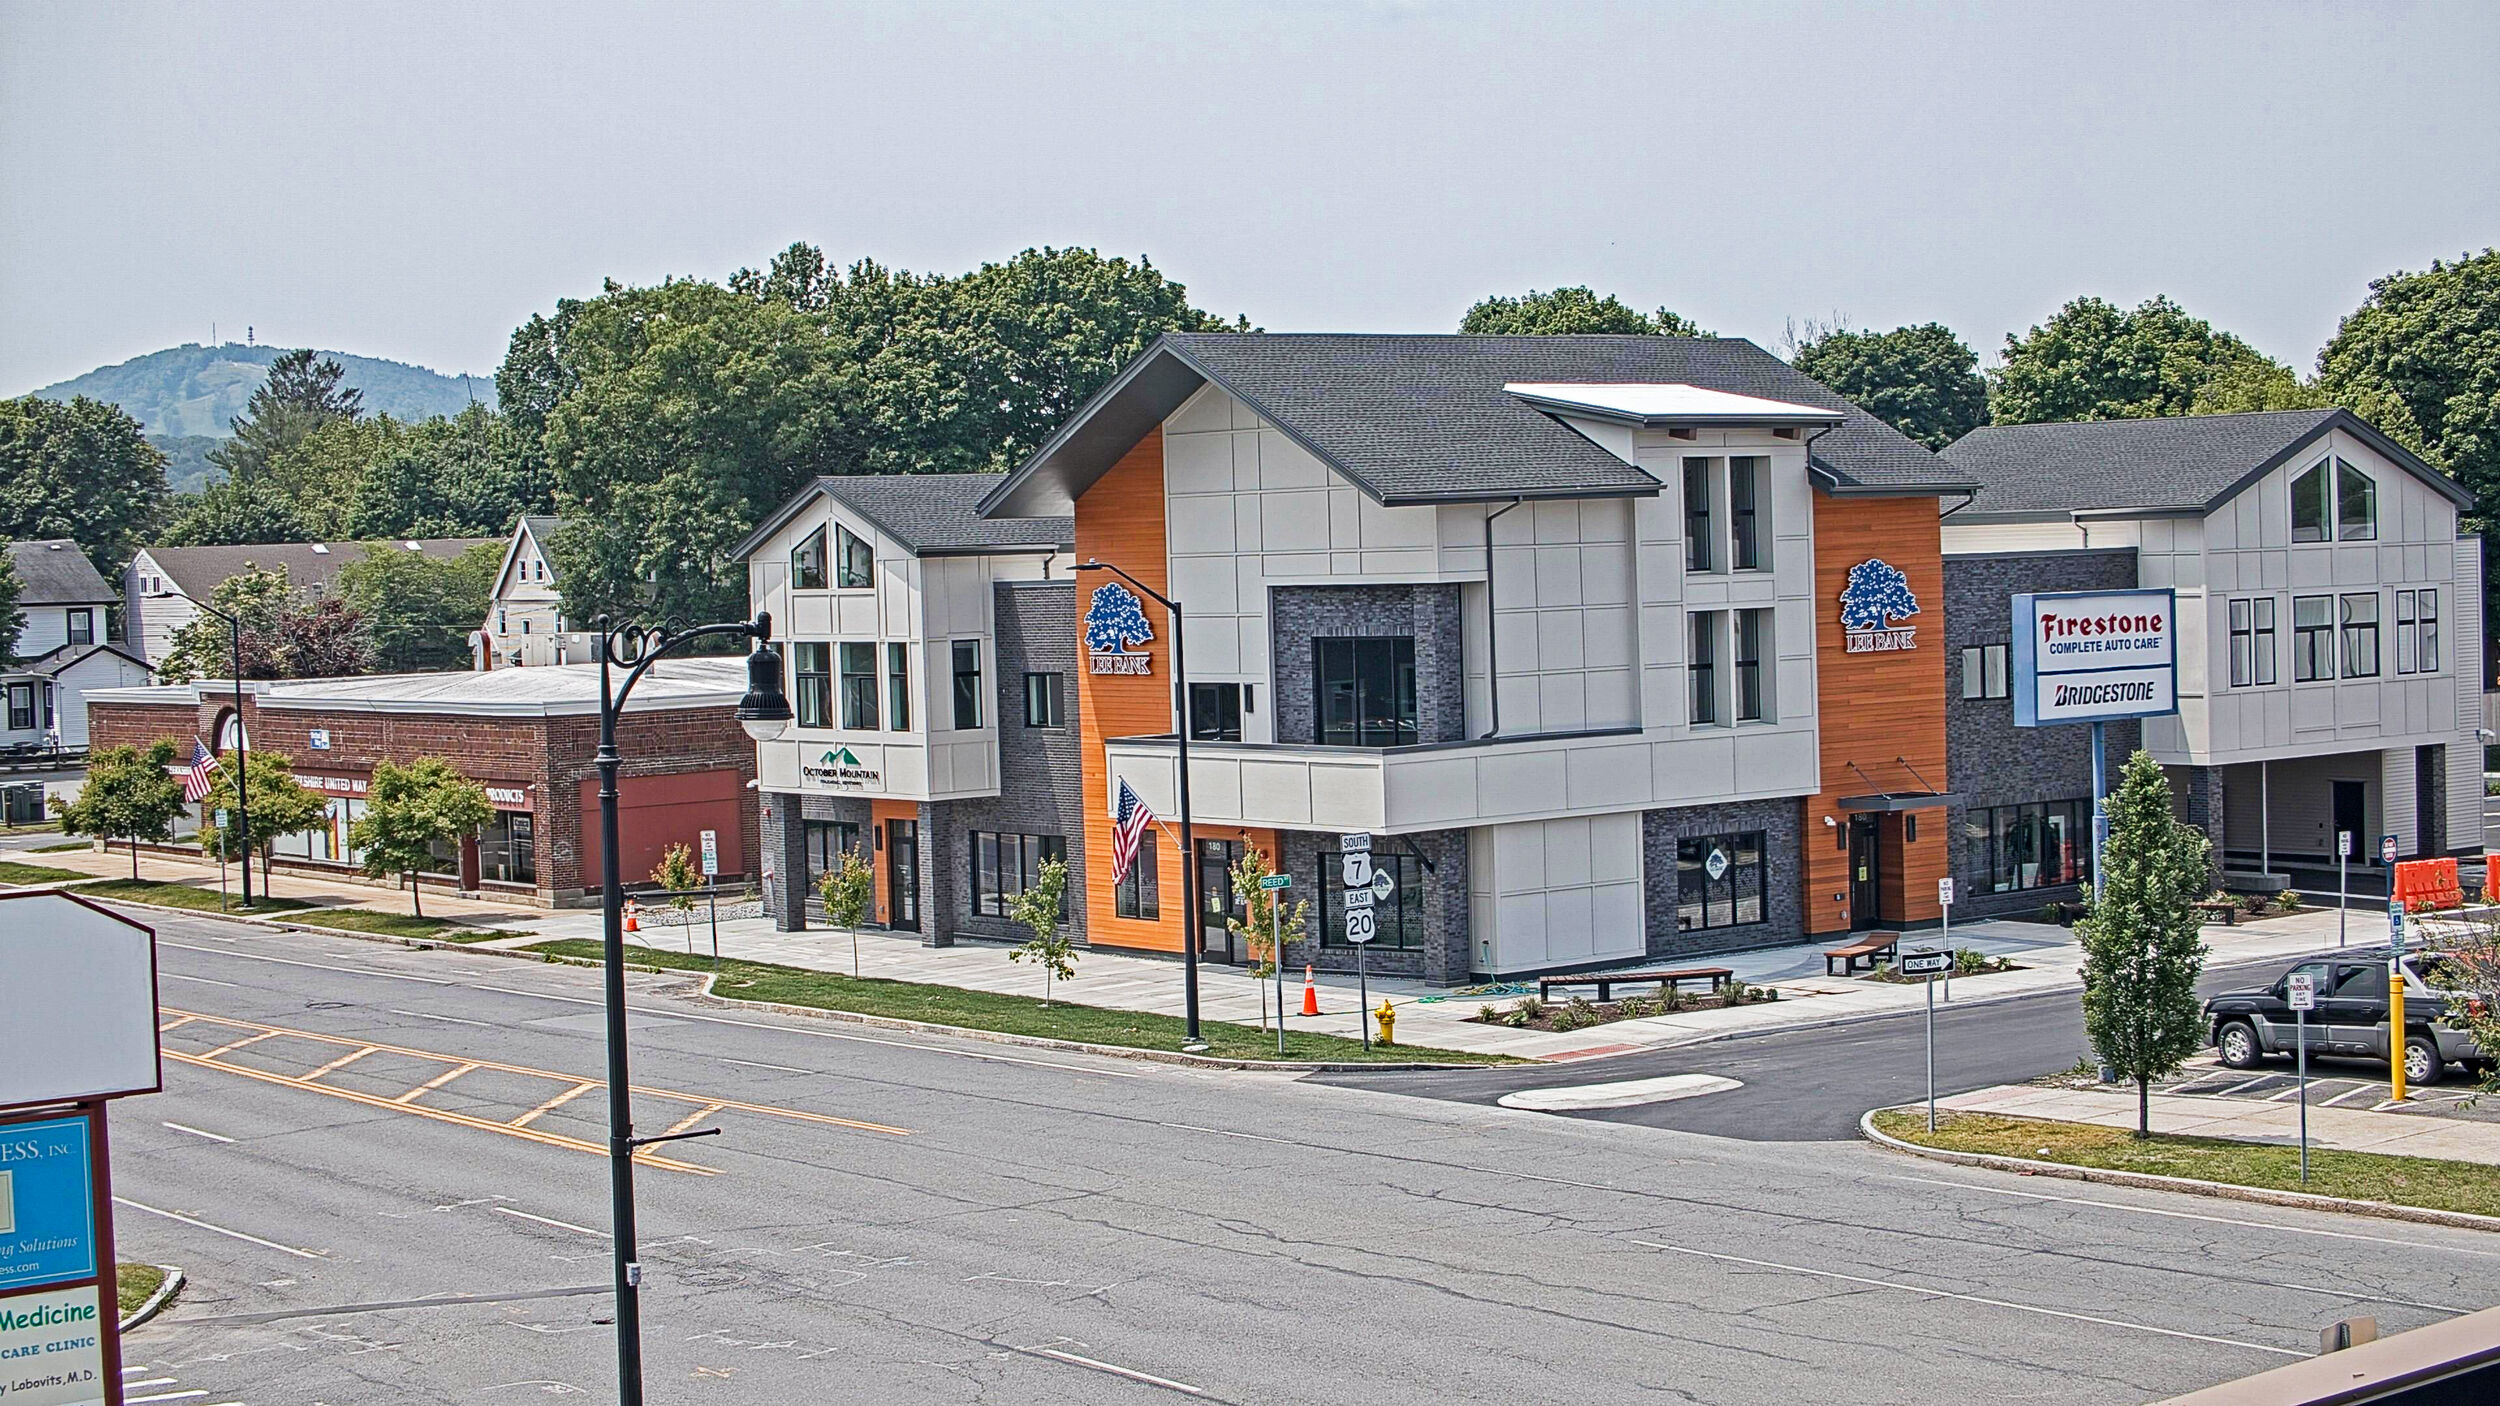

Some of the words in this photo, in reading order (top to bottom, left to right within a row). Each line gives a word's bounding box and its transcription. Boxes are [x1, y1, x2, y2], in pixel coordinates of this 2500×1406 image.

[2040, 613, 2163, 643] Firestone
[1846, 633, 1874, 653] LEE
[1875, 631, 1917, 651] BANK
[2050, 641, 2102, 655] COMPLETE
[2104, 639, 2131, 651] AUTO
[1089, 656, 1113, 674] LEE
[1113, 656, 1151, 674] BANK
[2054, 682, 2155, 707] BRIDGESTONE
[803, 766, 838, 777] OCTOBER
[840, 767, 880, 780] MOUNTAIN
[324, 777, 350, 791] UNITED
[352, 779, 367, 792] WAY
[486, 787, 524, 803] PRODUCTS
[1208, 841, 1221, 851] 180
[1343, 836, 1369, 849] SOUTH
[1351, 860, 1362, 880] 7
[1262, 877, 1284, 887] REED
[1349, 892, 1369, 904] EAST
[1348, 914, 1372, 936] 20
[1907, 959, 1924, 969] ONE
[1926, 957, 1941, 967] WAY
[19, 1235, 78, 1253] Solutions
[0, 1303, 96, 1331] Medicine
[1, 1344, 40, 1359] CARE
[46, 1337, 95, 1352] CLINIC
